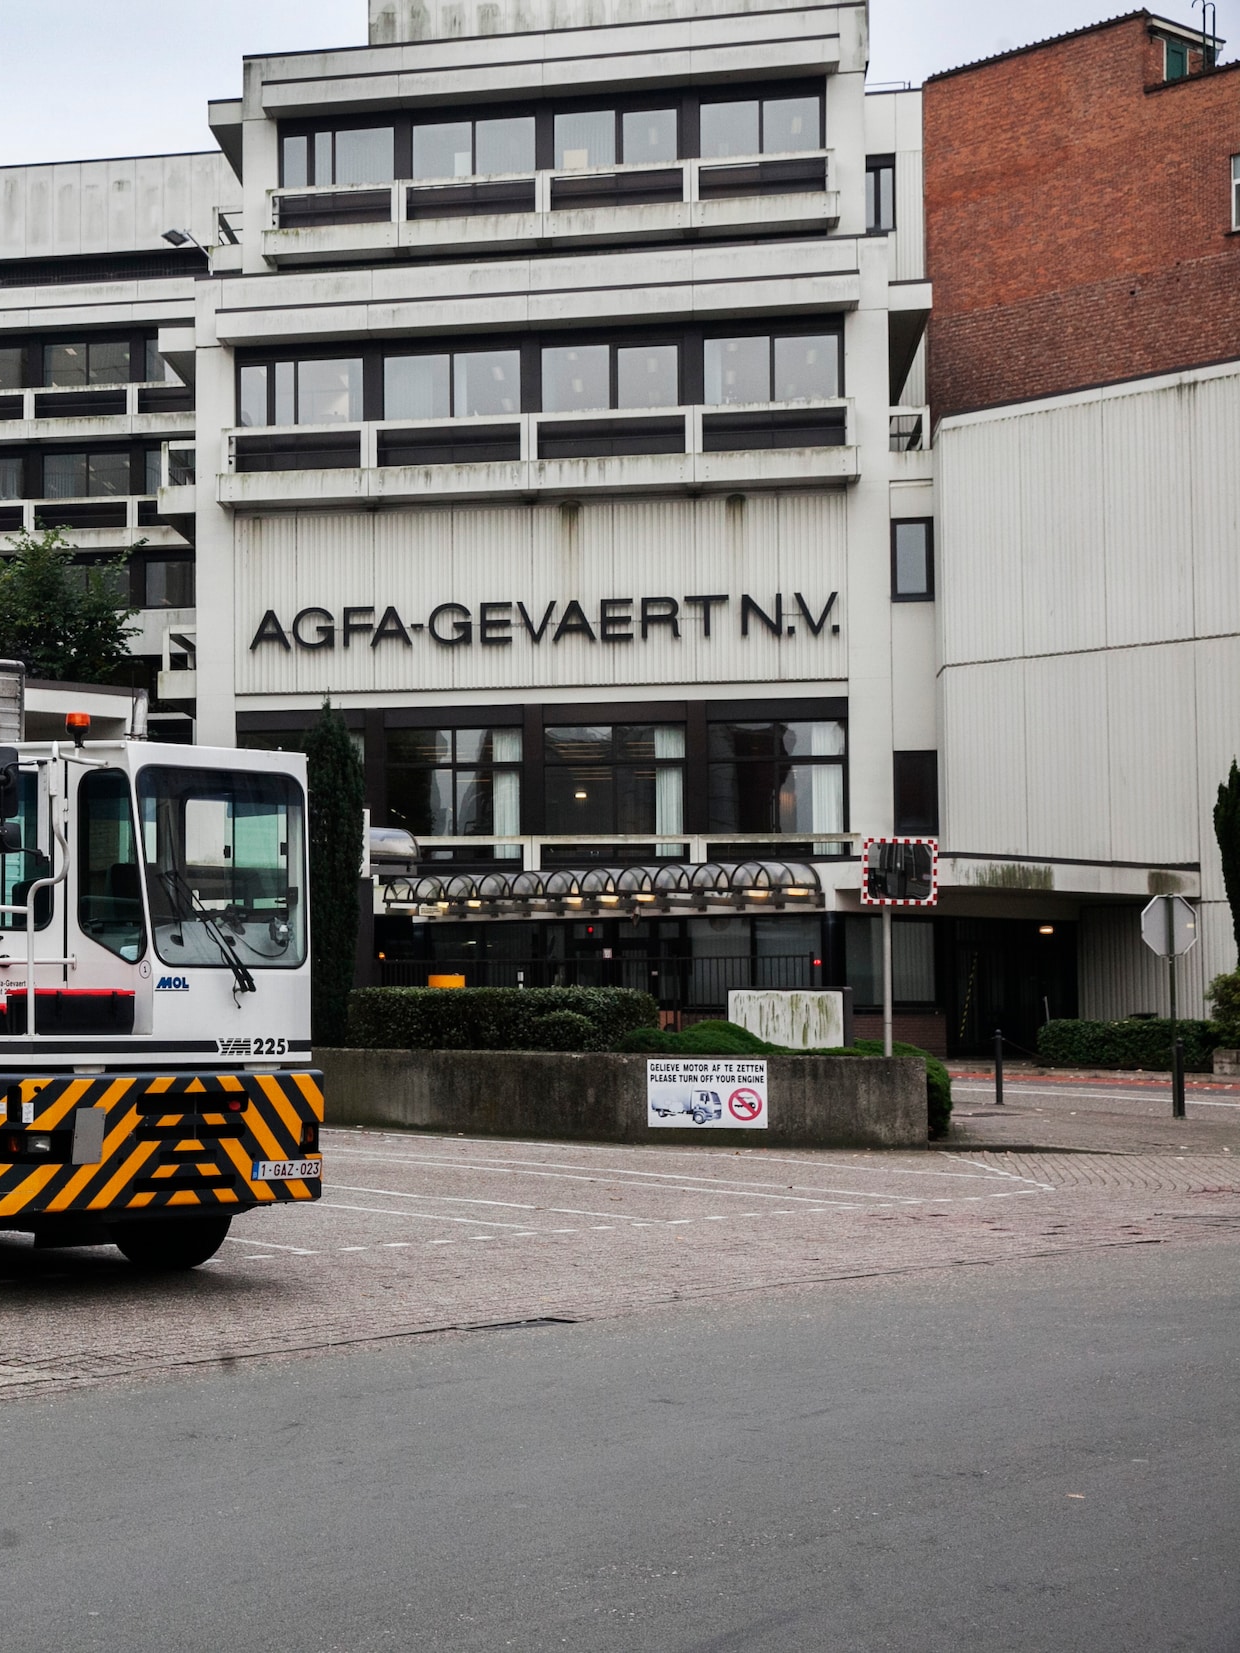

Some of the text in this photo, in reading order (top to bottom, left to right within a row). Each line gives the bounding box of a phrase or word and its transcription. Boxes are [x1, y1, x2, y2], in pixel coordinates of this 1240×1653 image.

[249, 591, 840, 650] AGFA-GEVAERT N.V.
[157, 976, 190, 989] MOL
[253, 1038, 286, 1055] 225
[650, 1063, 764, 1073] GELIEVE MOTOR AF TE ZETTEN
[650, 1074, 765, 1083] PLEASE TURN OFF YOUR ENGINE
